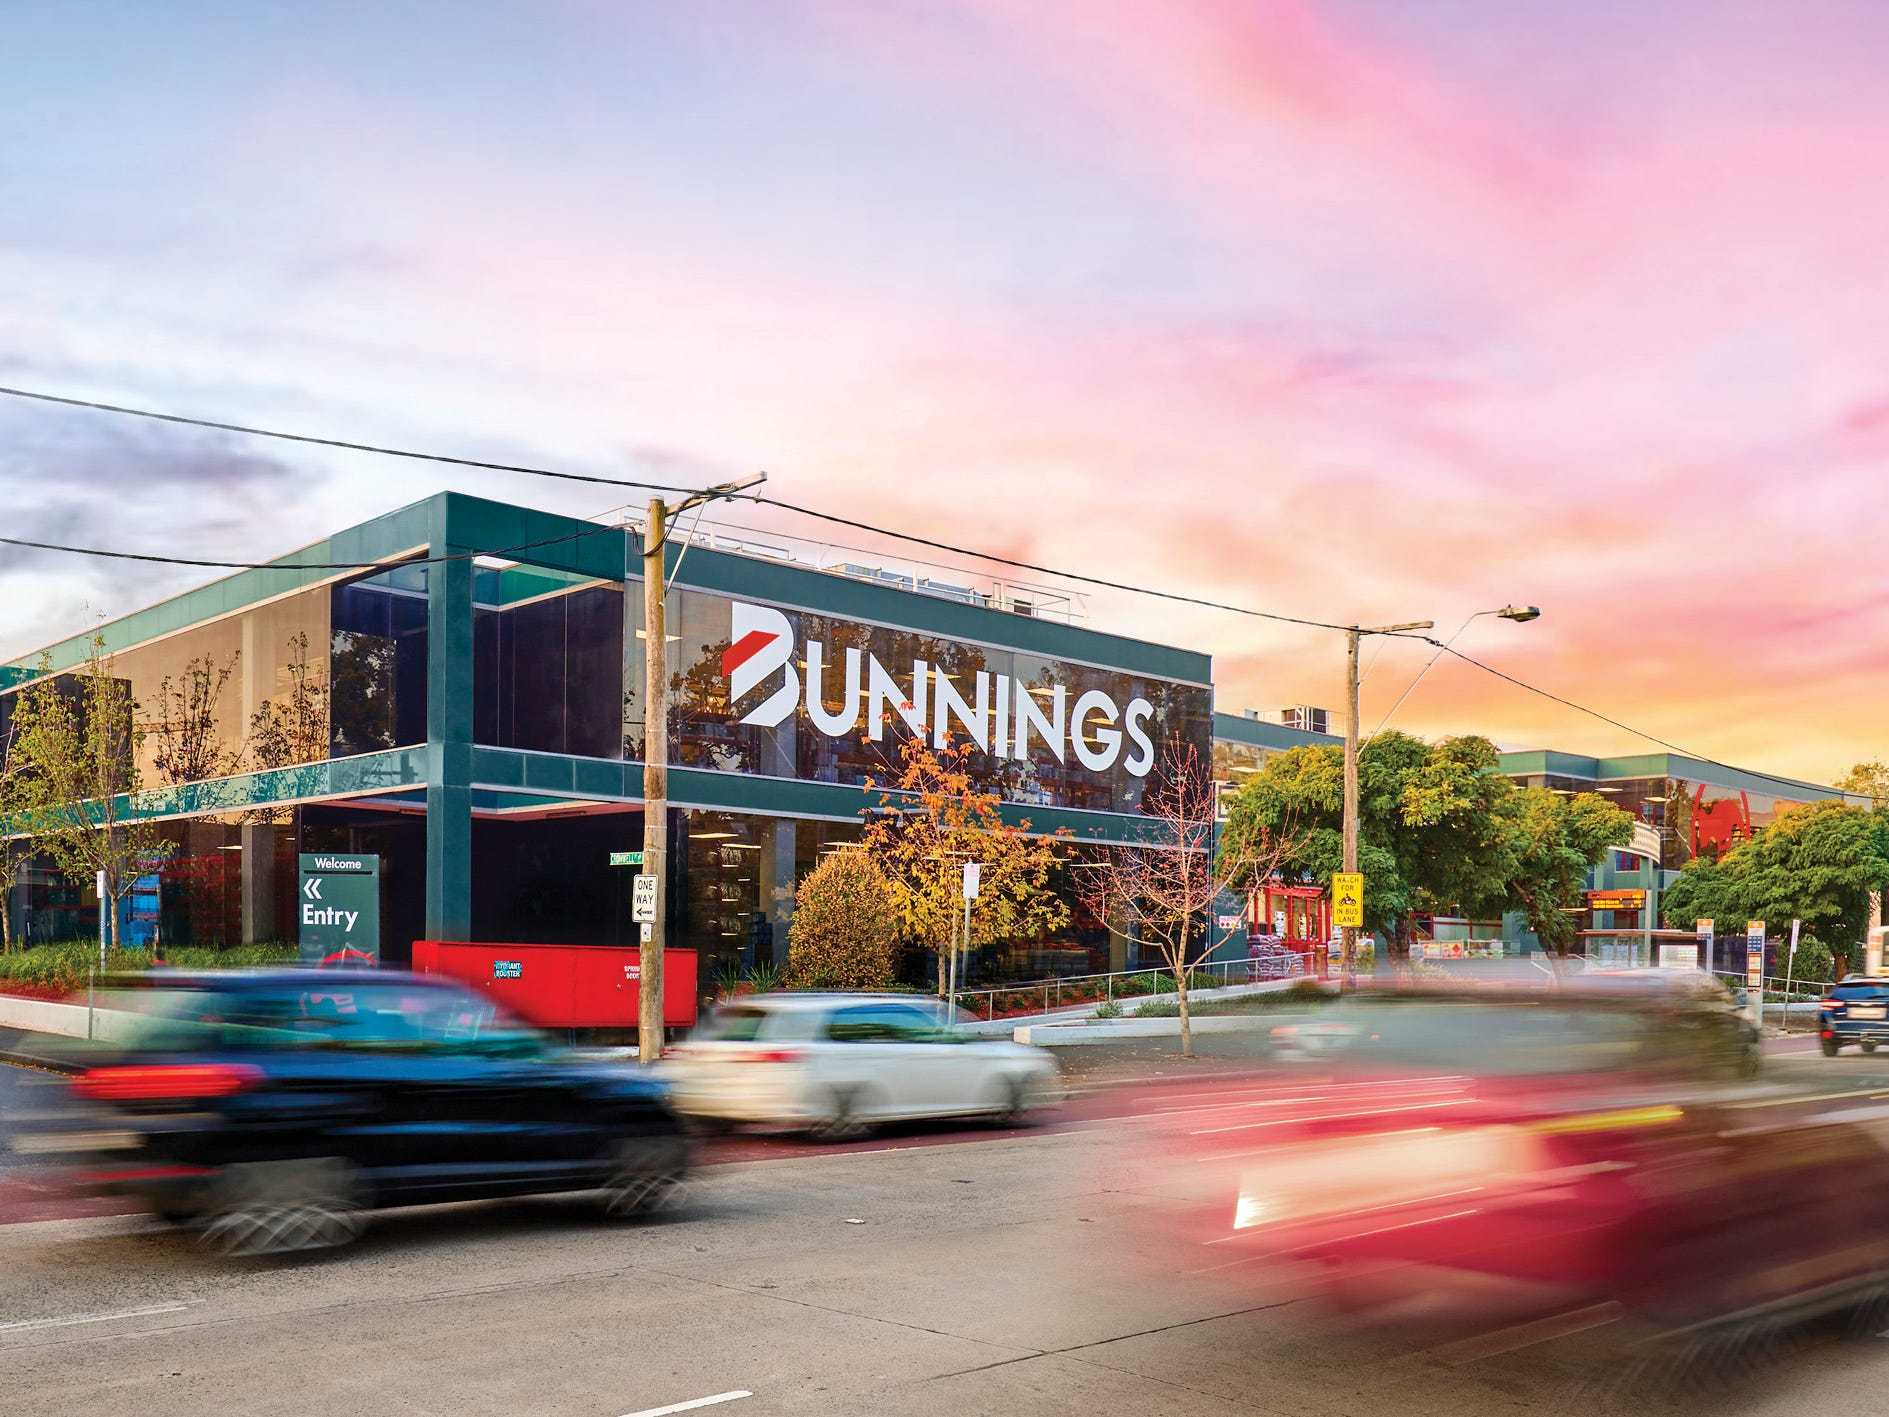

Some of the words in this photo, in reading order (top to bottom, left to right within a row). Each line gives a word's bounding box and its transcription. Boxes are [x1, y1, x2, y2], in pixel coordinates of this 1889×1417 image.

[722, 601, 1154, 777] BUNNINGS
[315, 857, 362, 869] Welcome
[638, 880, 653, 890] ONE
[636, 895, 653, 904] WAY
[303, 904, 359, 932] Entry
